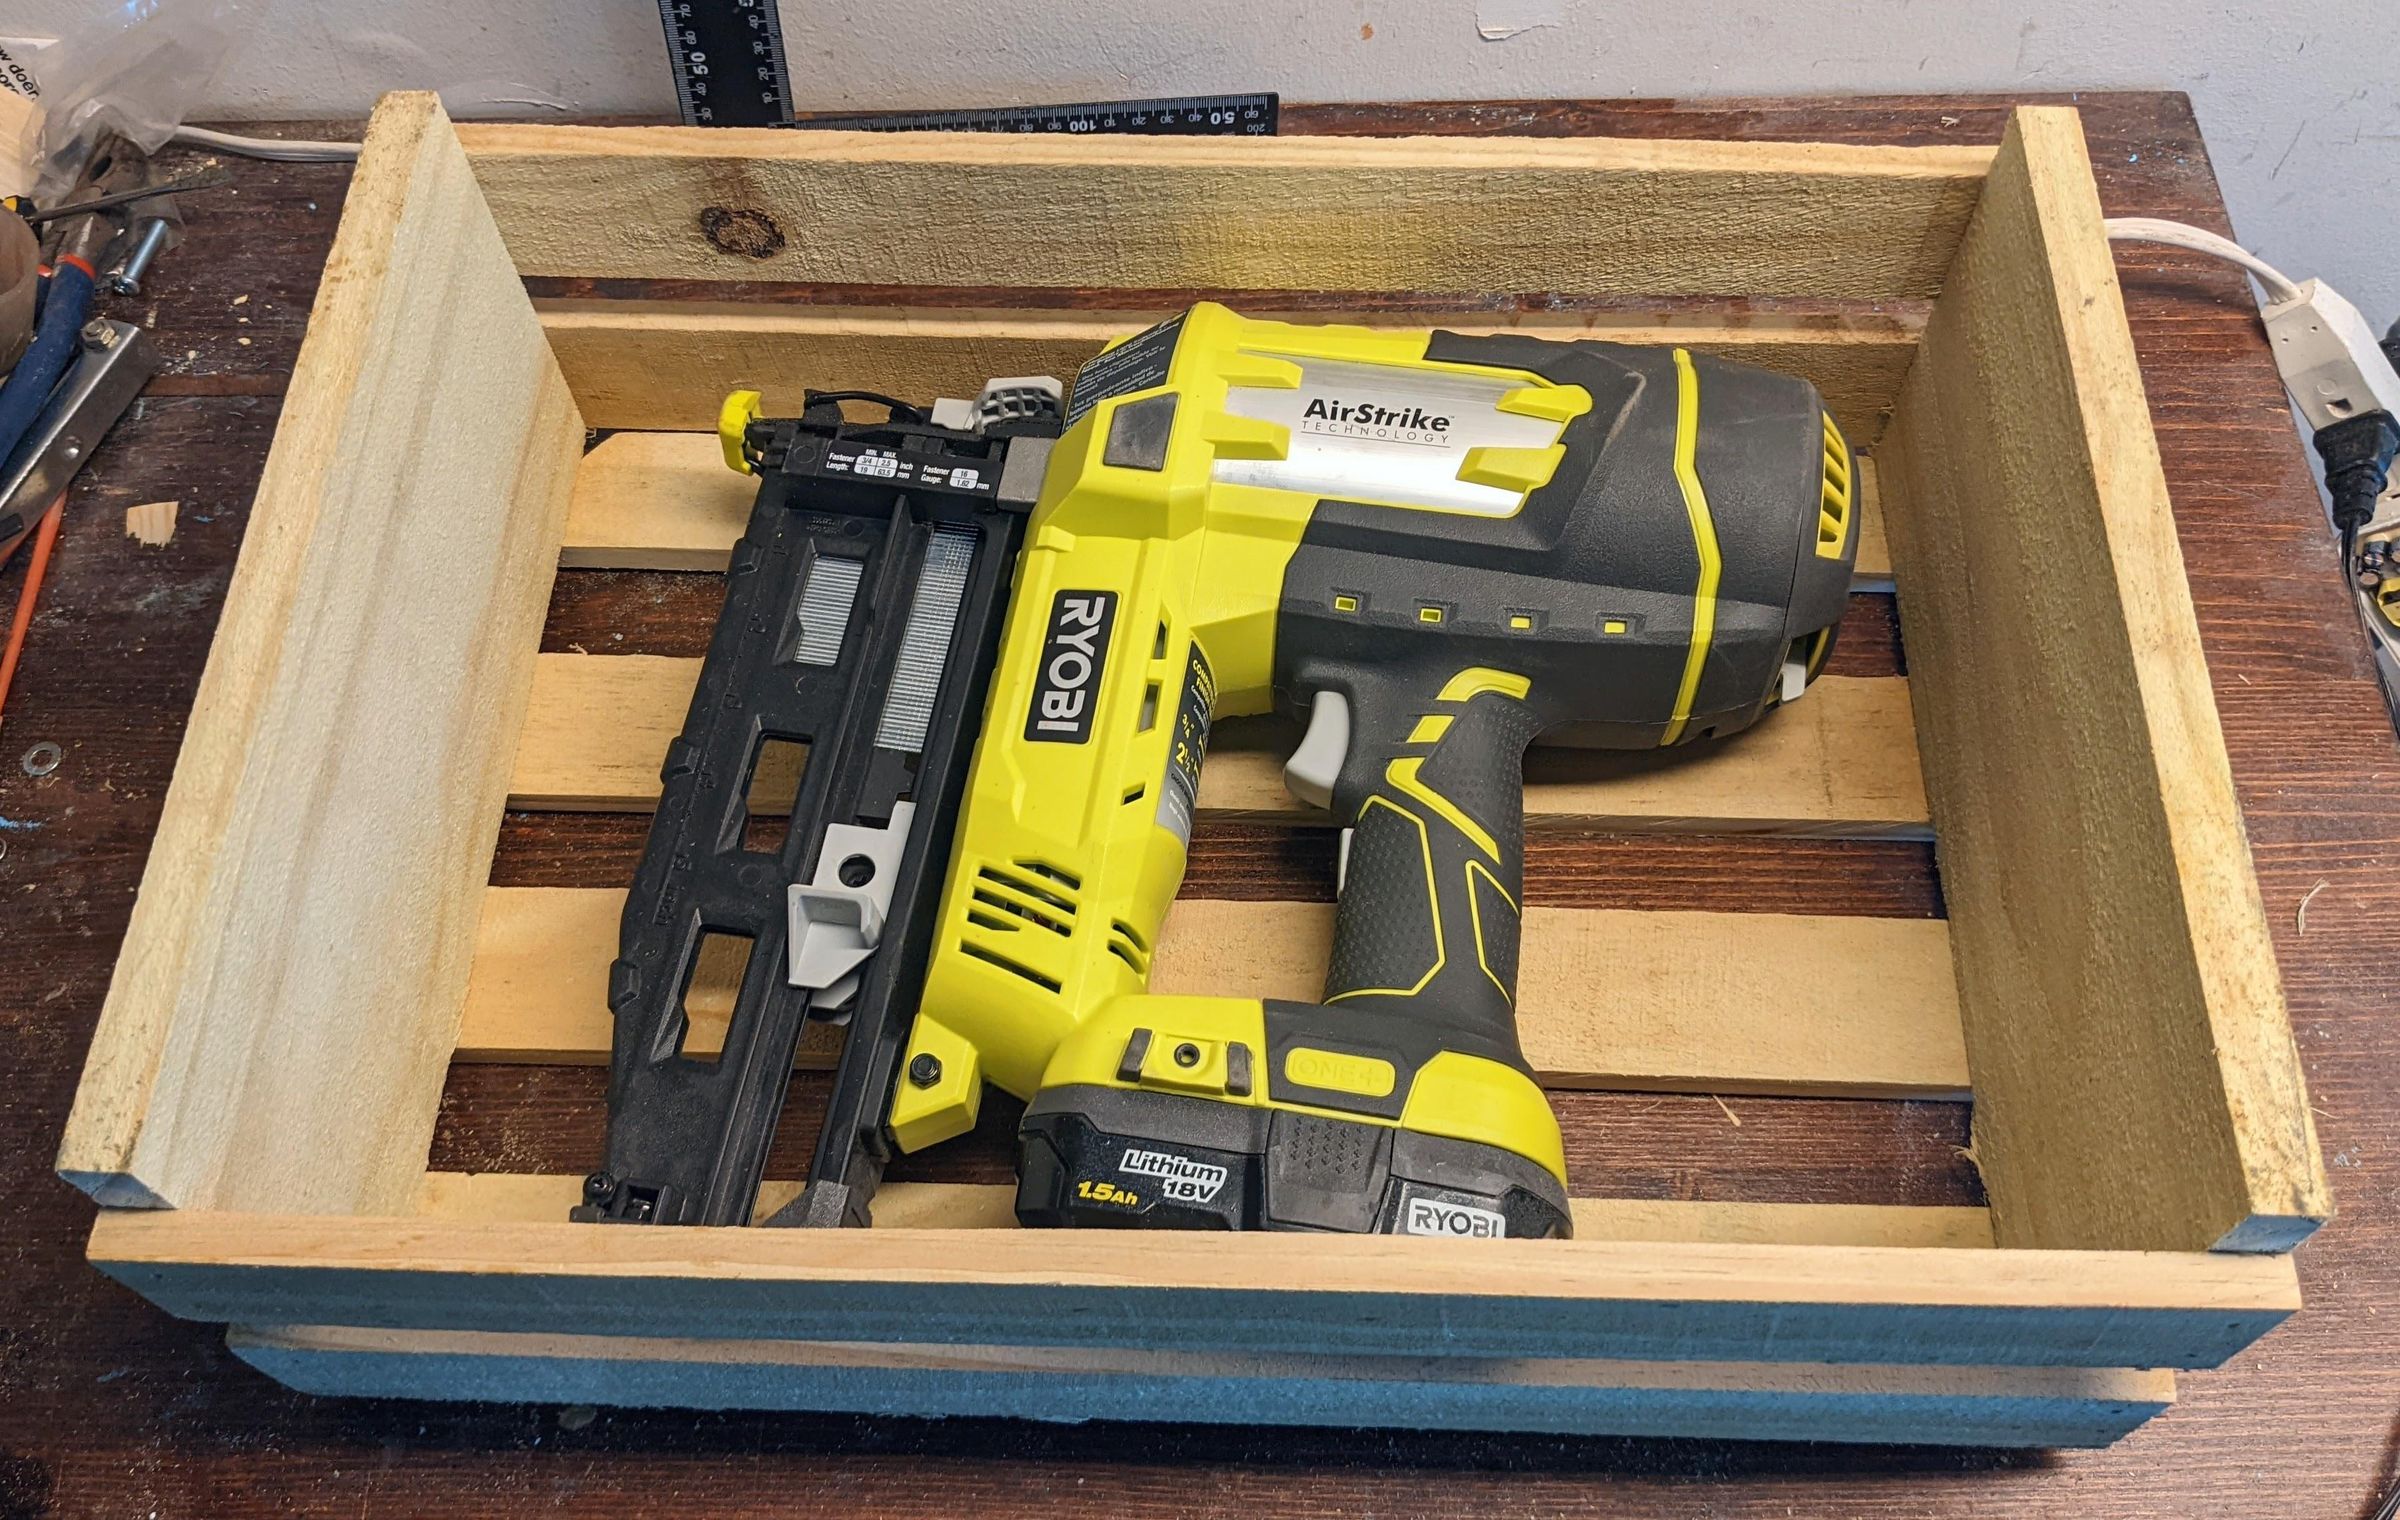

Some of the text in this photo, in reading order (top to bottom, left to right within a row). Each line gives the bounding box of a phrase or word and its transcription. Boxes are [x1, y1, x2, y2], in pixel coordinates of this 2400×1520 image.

[680, 4, 713, 120] 30 40 50 60 70
[748, 15, 773, 104] 10 20 30 40
[8, 64, 40, 102] doer
[1132, 117, 1146, 126] 20
[1161, 115, 1174, 124] 30
[1189, 114, 1203, 122] 40
[1211, 111, 1235, 125] 50
[1244, 110, 1258, 119] 60
[1070, 120, 1096, 132] 100
[1104, 119, 1116, 127] 10
[1247, 124, 1266, 132] 200
[1303, 398, 1450, 432] AirStrike
[1302, 420, 1449, 444] TECHNOLOGY
[828, 452, 914, 471] Fastener 3/4 2.5 inch
[860, 466, 869, 474] 19
[897, 471, 910, 480] mm
[923, 465, 968, 478] Fastener 16
[976, 482, 990, 490] mm
[1036, 596, 1106, 732] RYOBI
[1124, 1152, 1223, 1182] Lithium
[1078, 1181, 1217, 1206] 1.5Ah 18V
[1415, 1204, 1498, 1238] RYOBI
